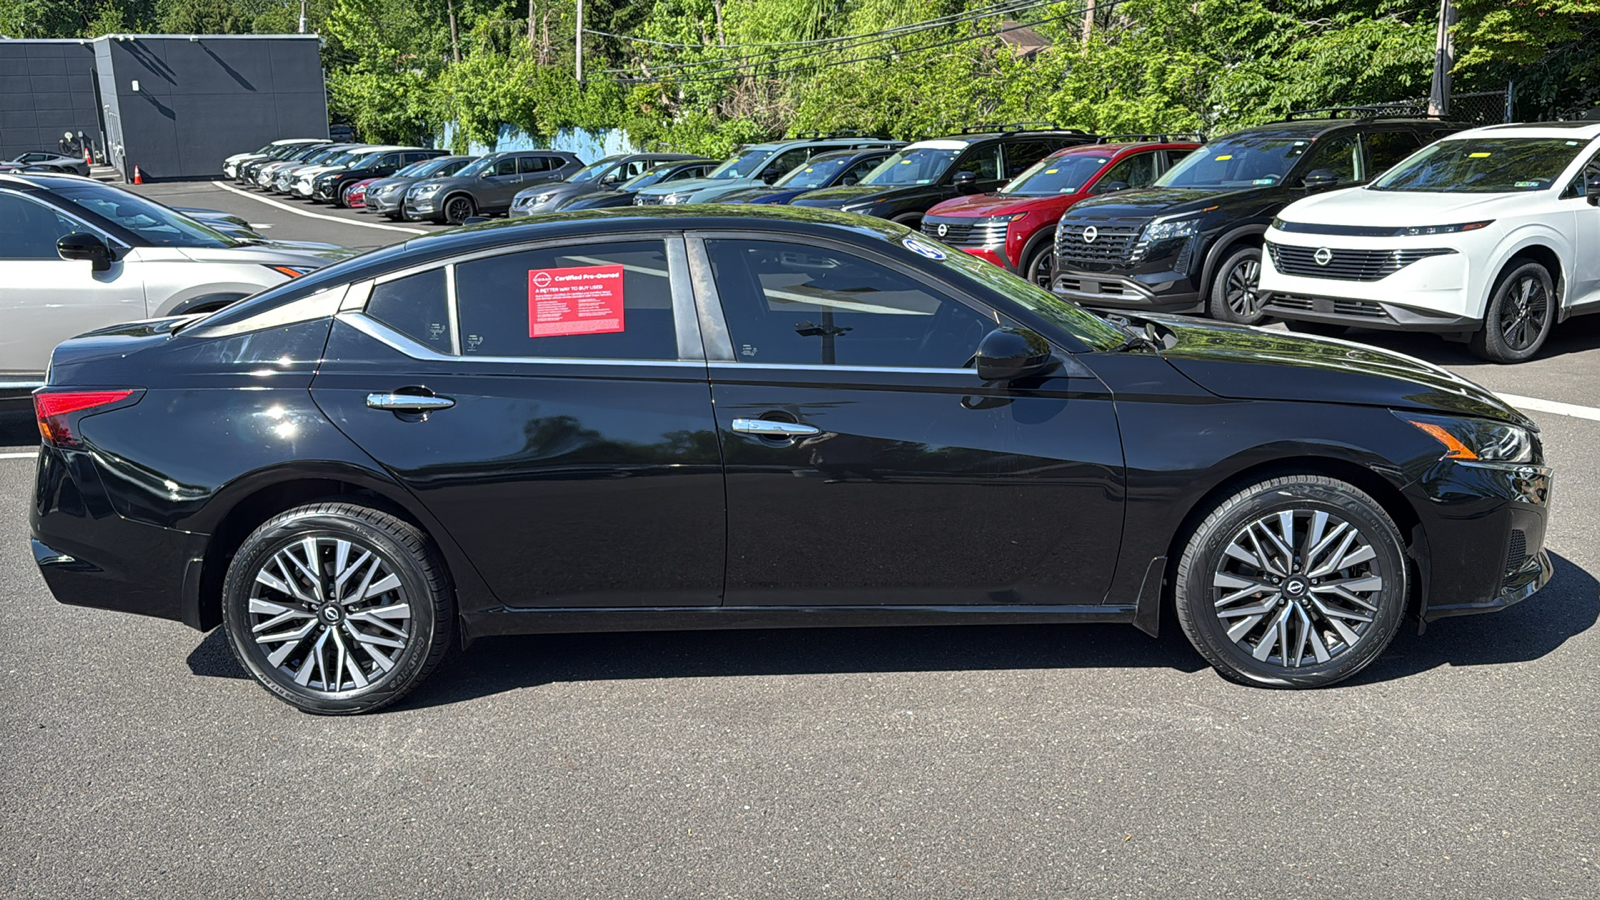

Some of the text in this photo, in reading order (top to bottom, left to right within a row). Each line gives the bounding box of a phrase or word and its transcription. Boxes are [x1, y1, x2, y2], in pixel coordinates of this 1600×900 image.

[554, 272, 620, 282] Certified Pre-Owned
[388, 636, 427, 690] GeoDrive
